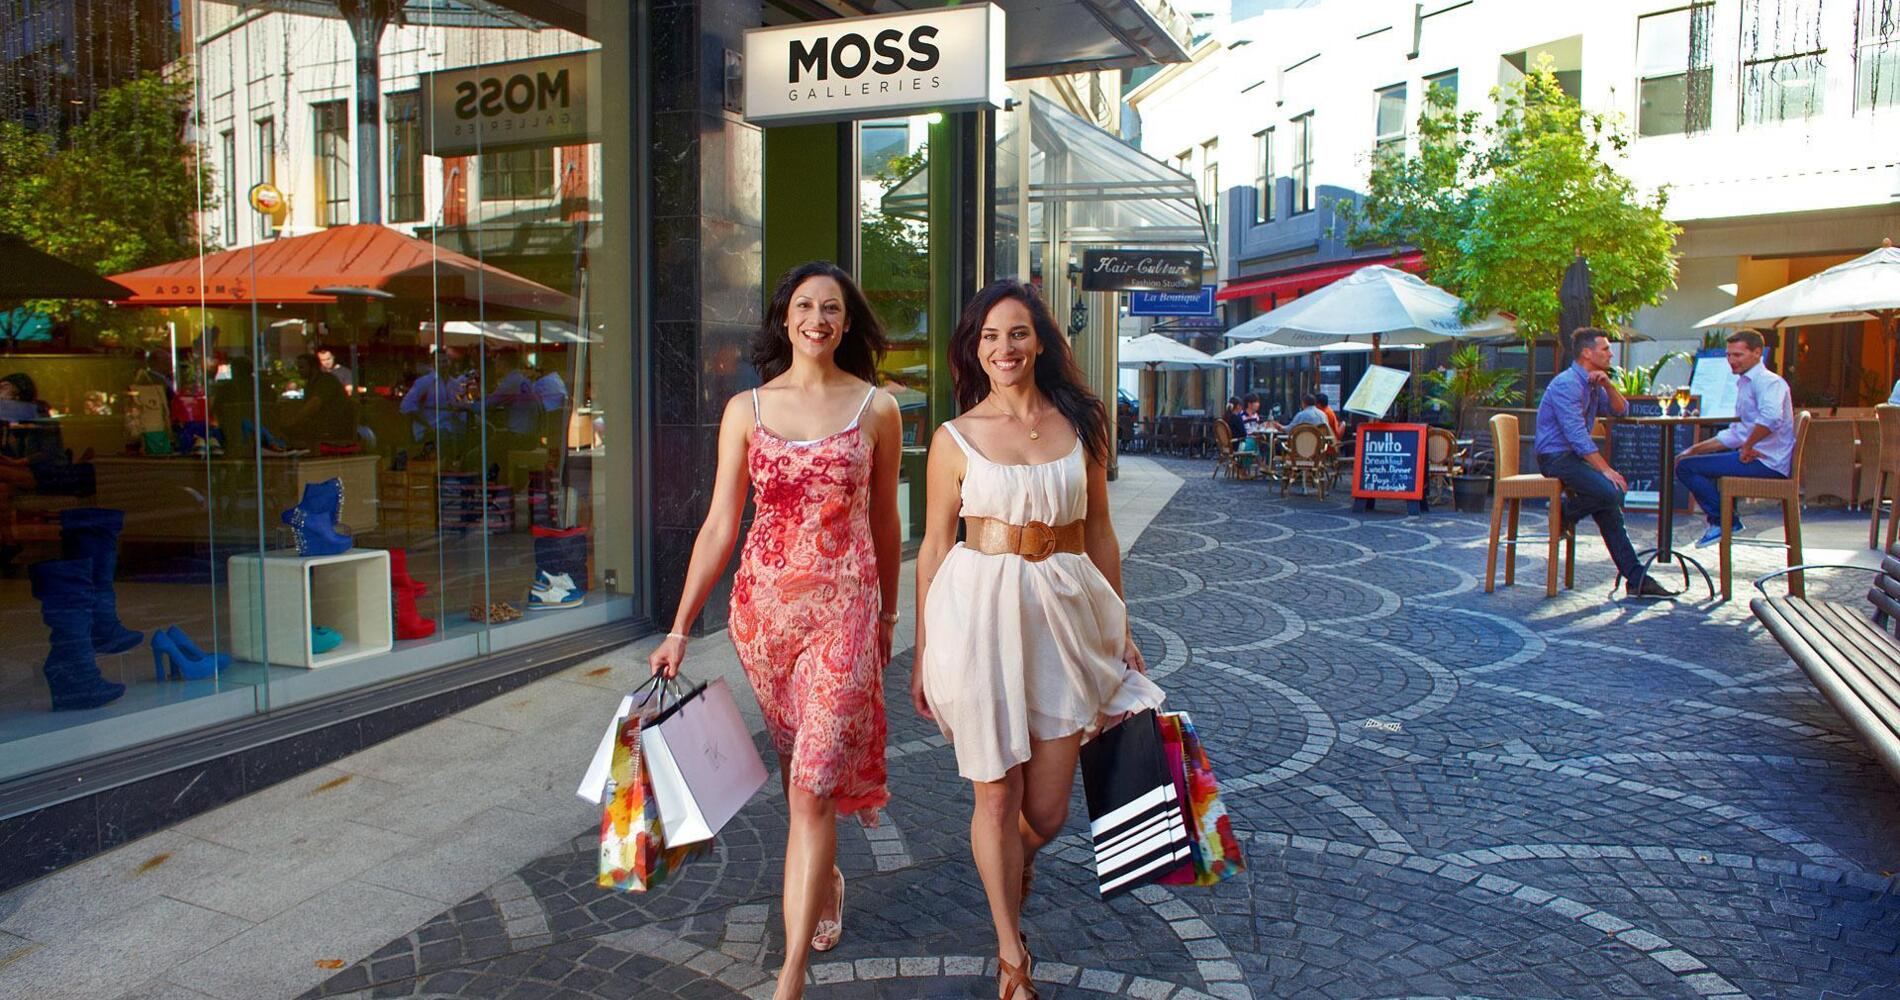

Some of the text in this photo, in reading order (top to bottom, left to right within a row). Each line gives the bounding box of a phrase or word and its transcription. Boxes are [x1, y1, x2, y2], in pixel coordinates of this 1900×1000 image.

[789, 25, 940, 84] MOSS
[788, 76, 942, 101] GALLERIES
[1093, 256, 1190, 275] Hair Culture
[1131, 279, 1189, 288] Fashion Studio
[1143, 293, 1201, 305] La Boutique
